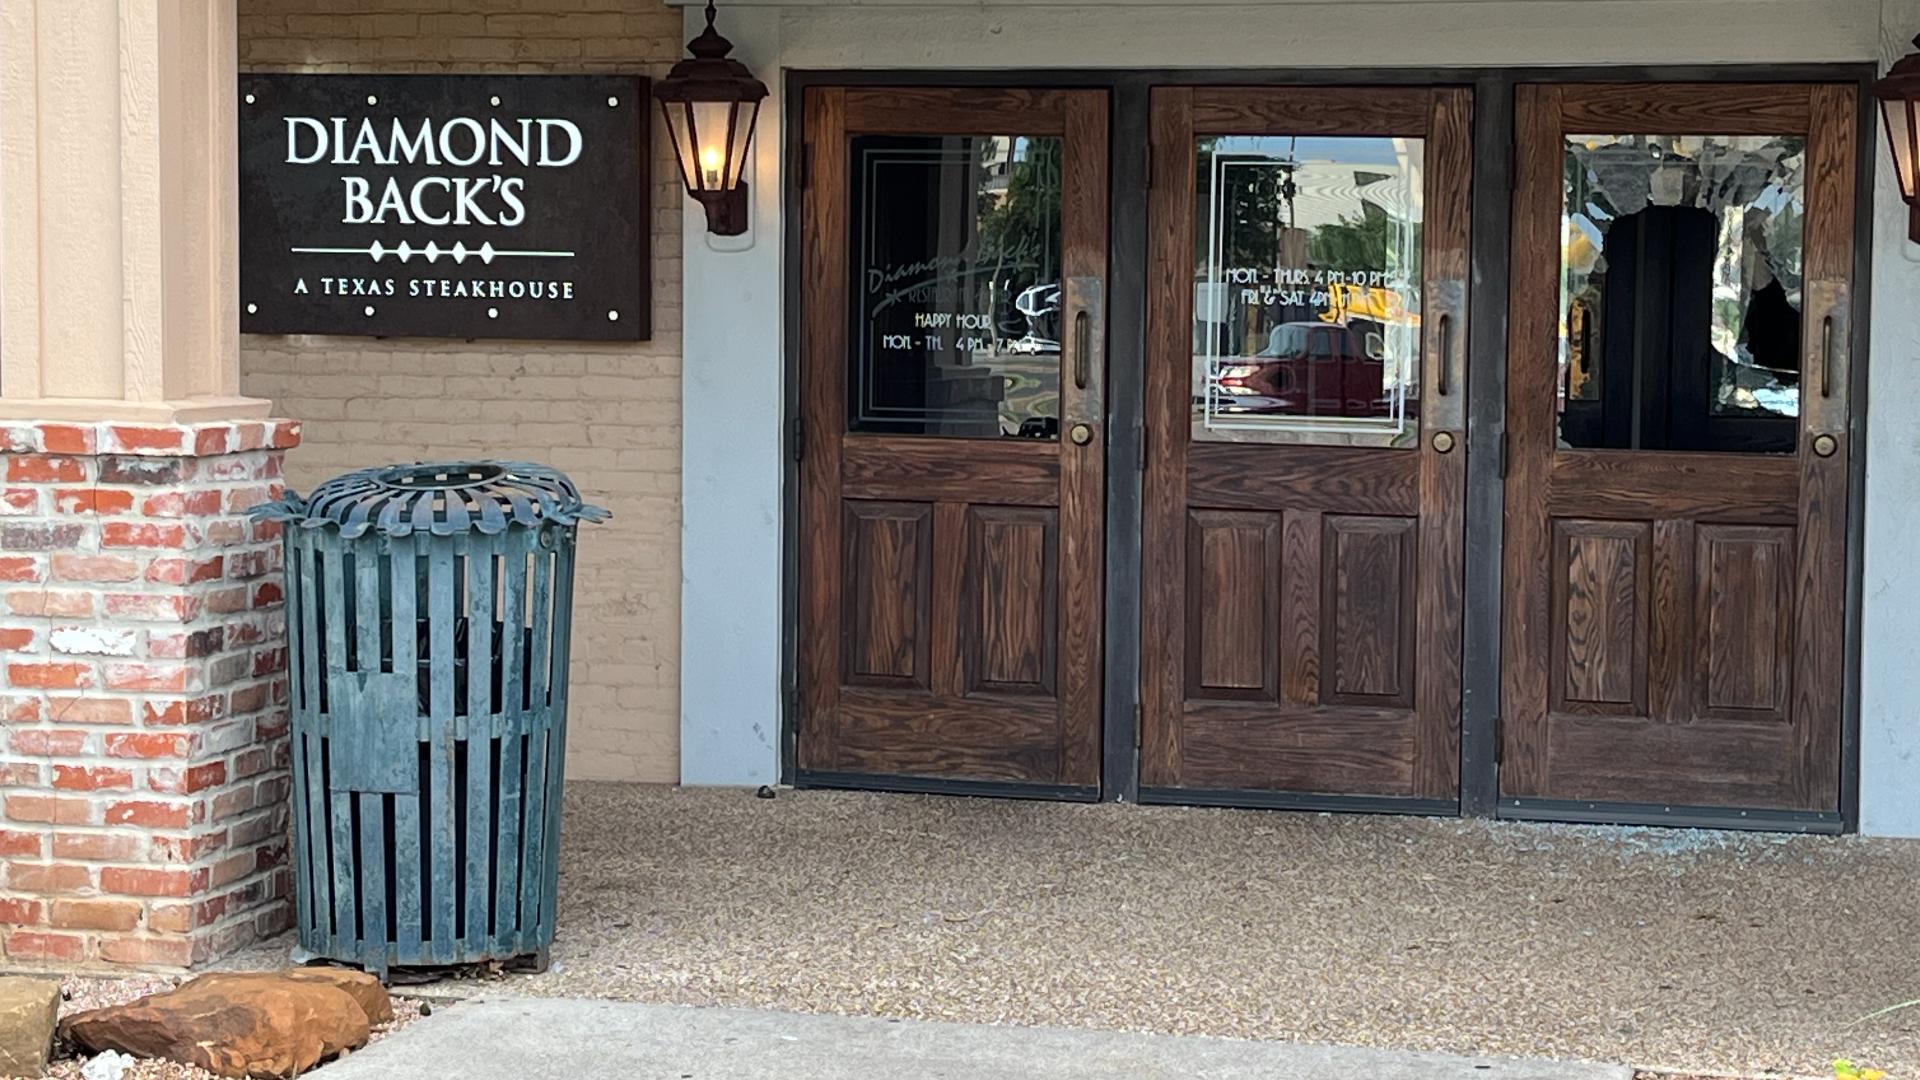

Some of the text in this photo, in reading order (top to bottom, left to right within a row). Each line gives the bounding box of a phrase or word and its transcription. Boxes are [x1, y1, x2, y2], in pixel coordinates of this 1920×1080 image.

[283, 116, 583, 167] DIAMOND
[341, 174, 526, 227] BACK'S
[1314, 269, 1324, 285] 4
[294, 278, 574, 300] A TEXAS STEAKHOUSE
[914, 312, 952, 328] HAPPY
[955, 337, 965, 351] 4
